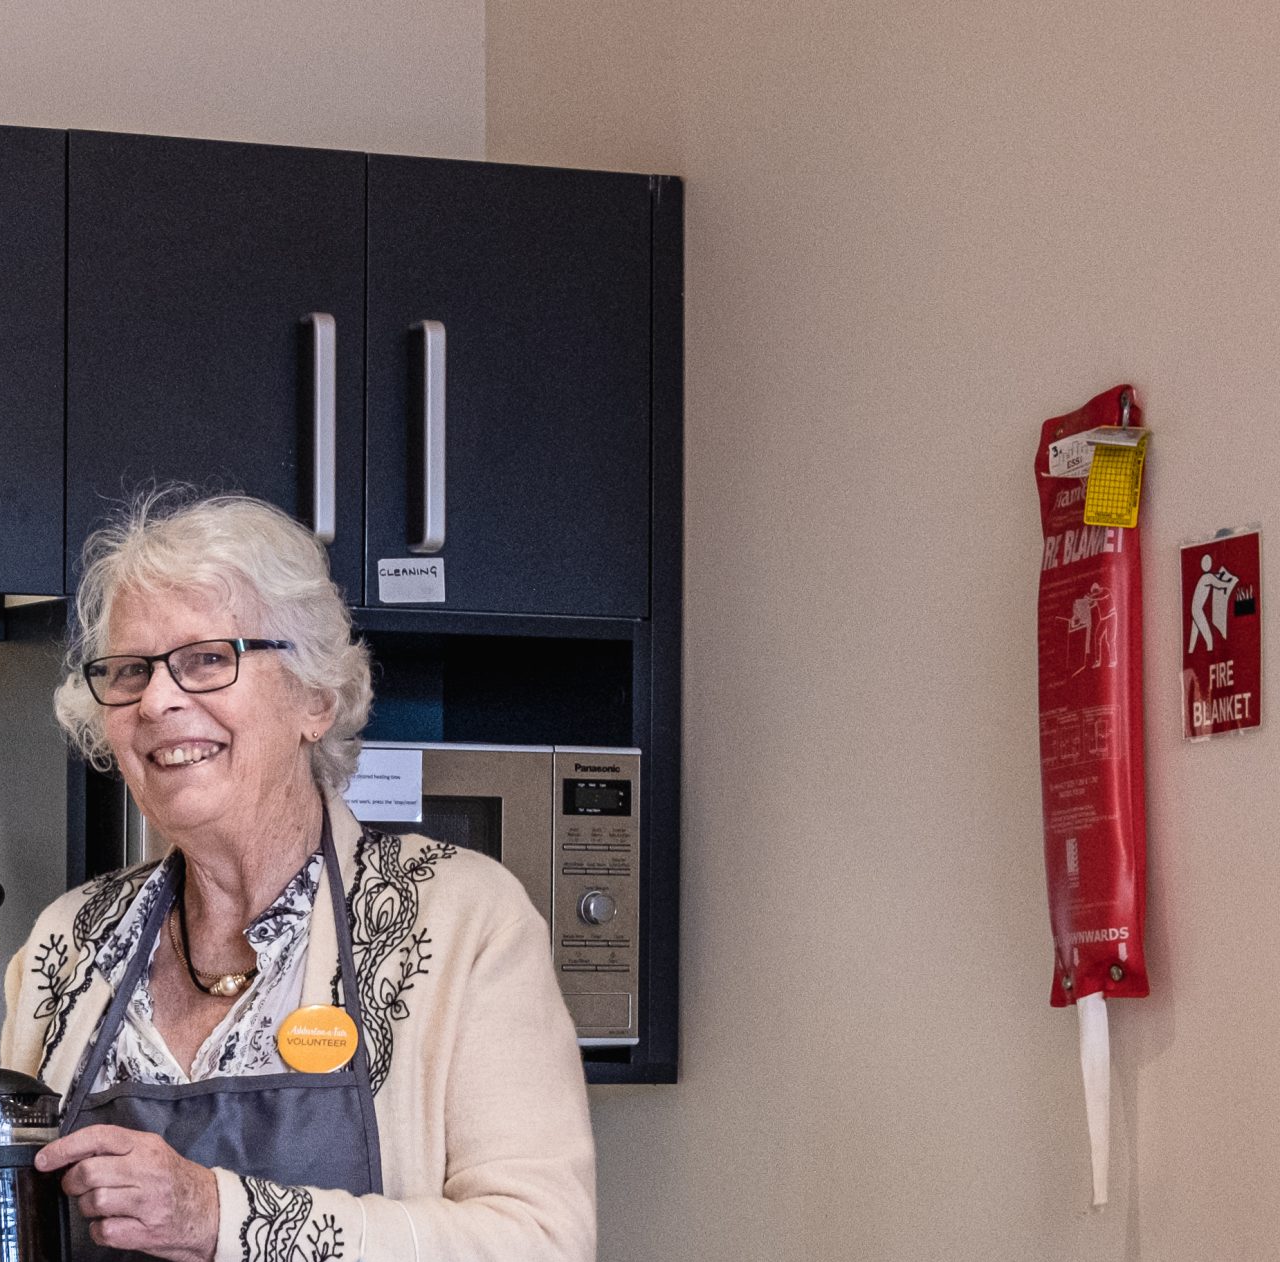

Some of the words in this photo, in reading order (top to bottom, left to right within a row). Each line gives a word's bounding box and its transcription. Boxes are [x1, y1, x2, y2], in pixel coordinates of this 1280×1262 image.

[1042, 534, 1063, 571] RE
[379, 565, 438, 578] CLEANING
[1209, 660, 1235, 690] FIRE
[1193, 692, 1252, 728] BLANKET
[574, 763, 621, 773] Panasonic
[286, 1038, 347, 1047] VOLUNTEER
